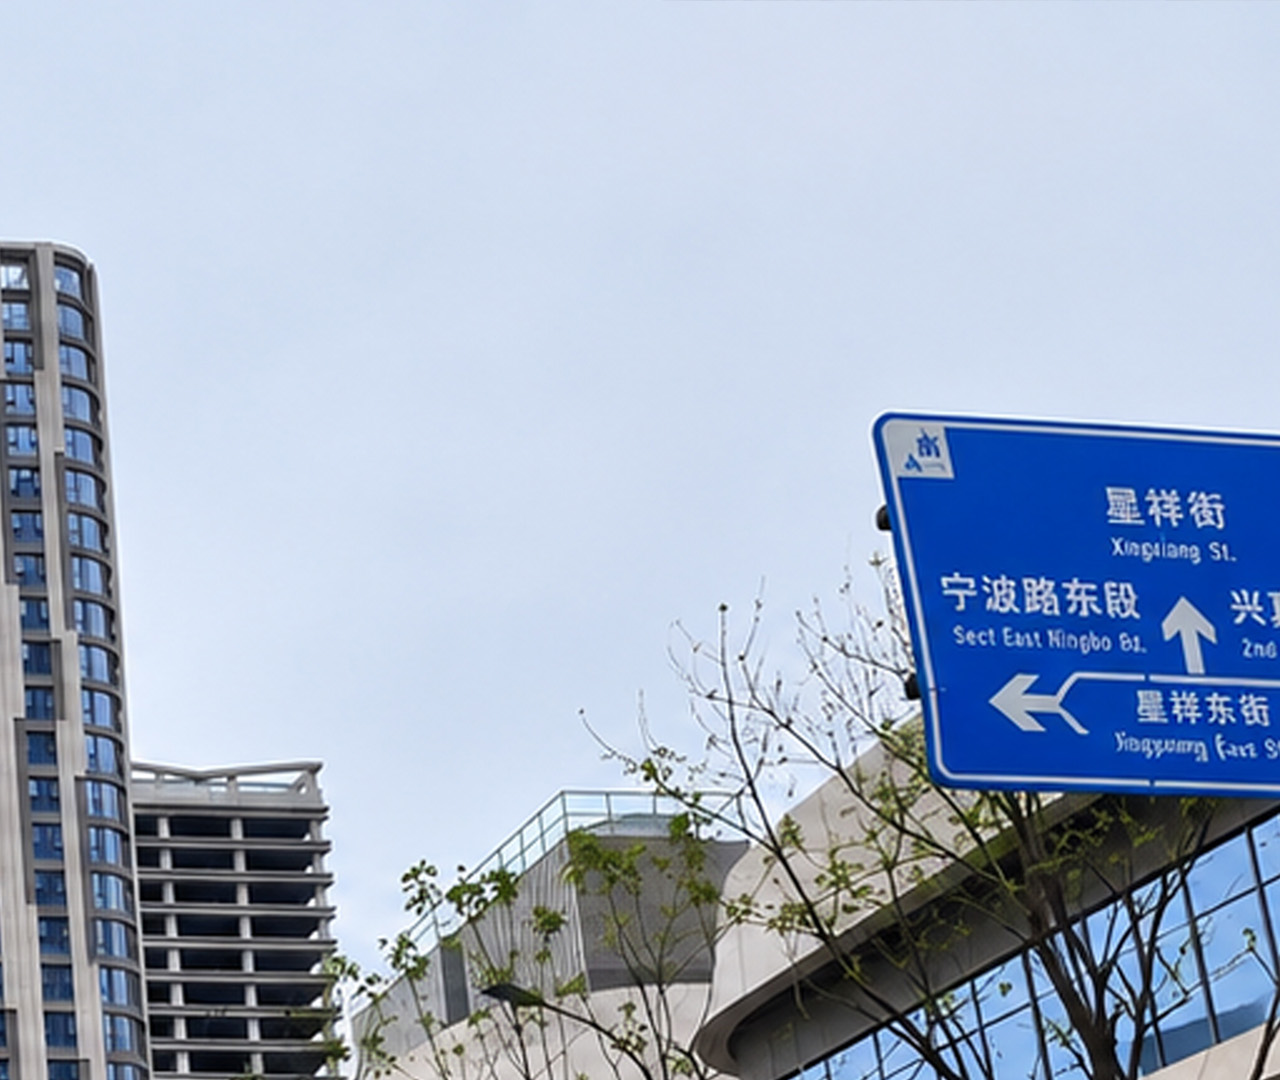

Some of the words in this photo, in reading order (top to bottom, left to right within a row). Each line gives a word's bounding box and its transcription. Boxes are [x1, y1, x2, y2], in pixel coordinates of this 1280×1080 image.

[1106, 486, 1225, 530] 星祥街
[941, 572, 1140, 619] 宁波路东段
[953, 625, 996, 647] Sect
[1136, 689, 1270, 727] 星祥东街
